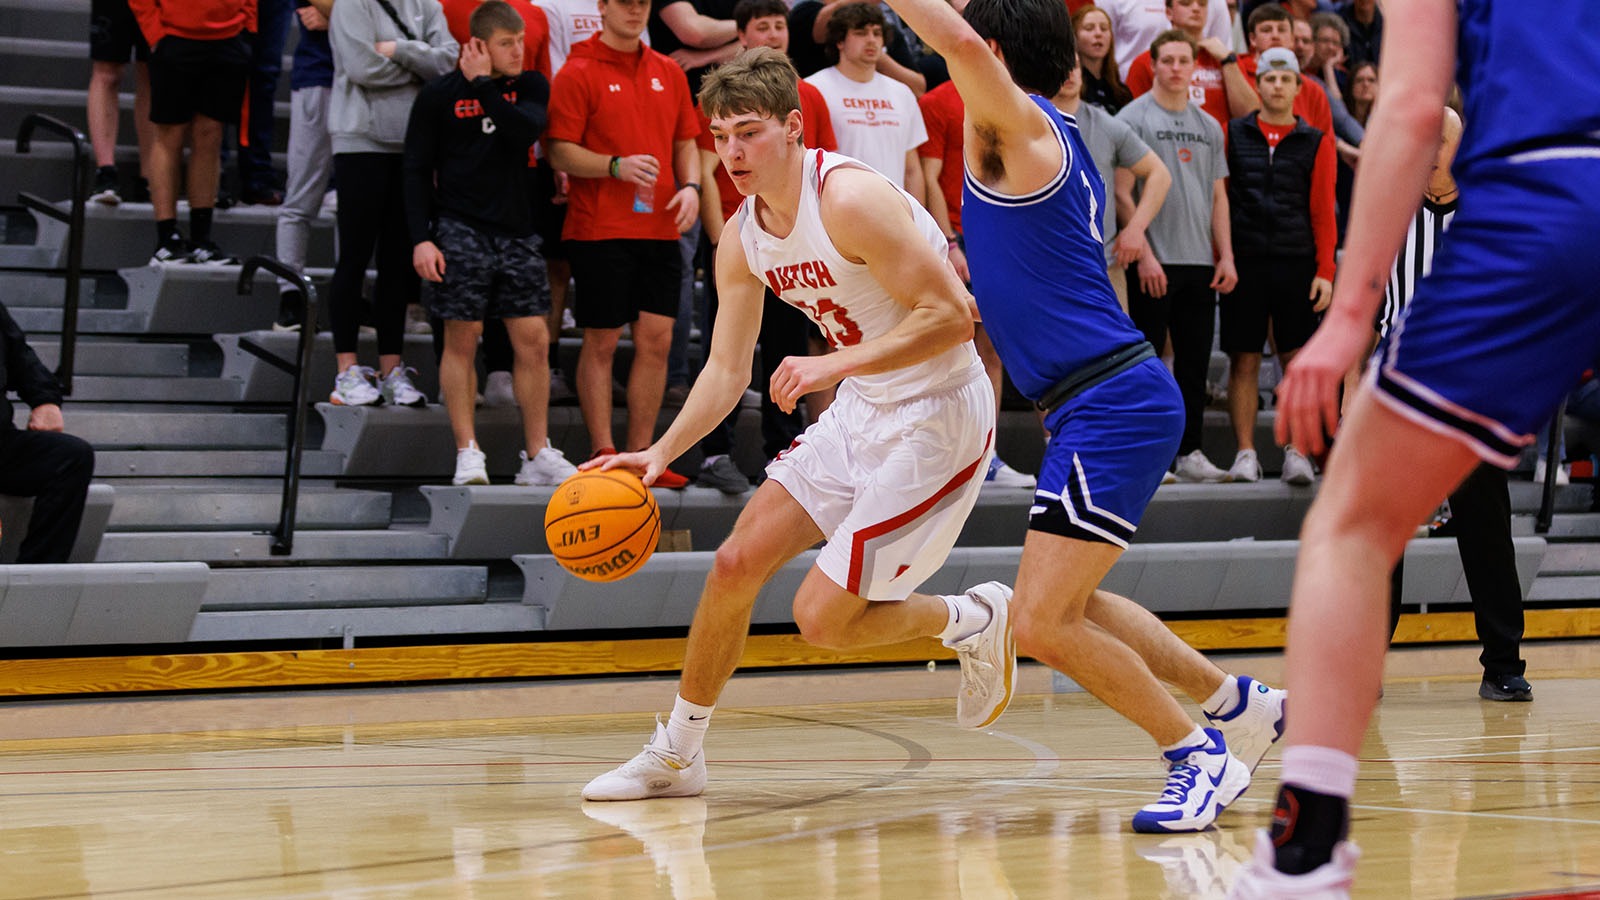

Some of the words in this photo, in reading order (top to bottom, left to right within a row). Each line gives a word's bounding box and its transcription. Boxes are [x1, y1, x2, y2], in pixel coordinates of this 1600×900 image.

[843, 97, 894, 111] CENTRAL
[1156, 130, 1212, 147] CENTRAL
[562, 524, 601, 547] EVO
